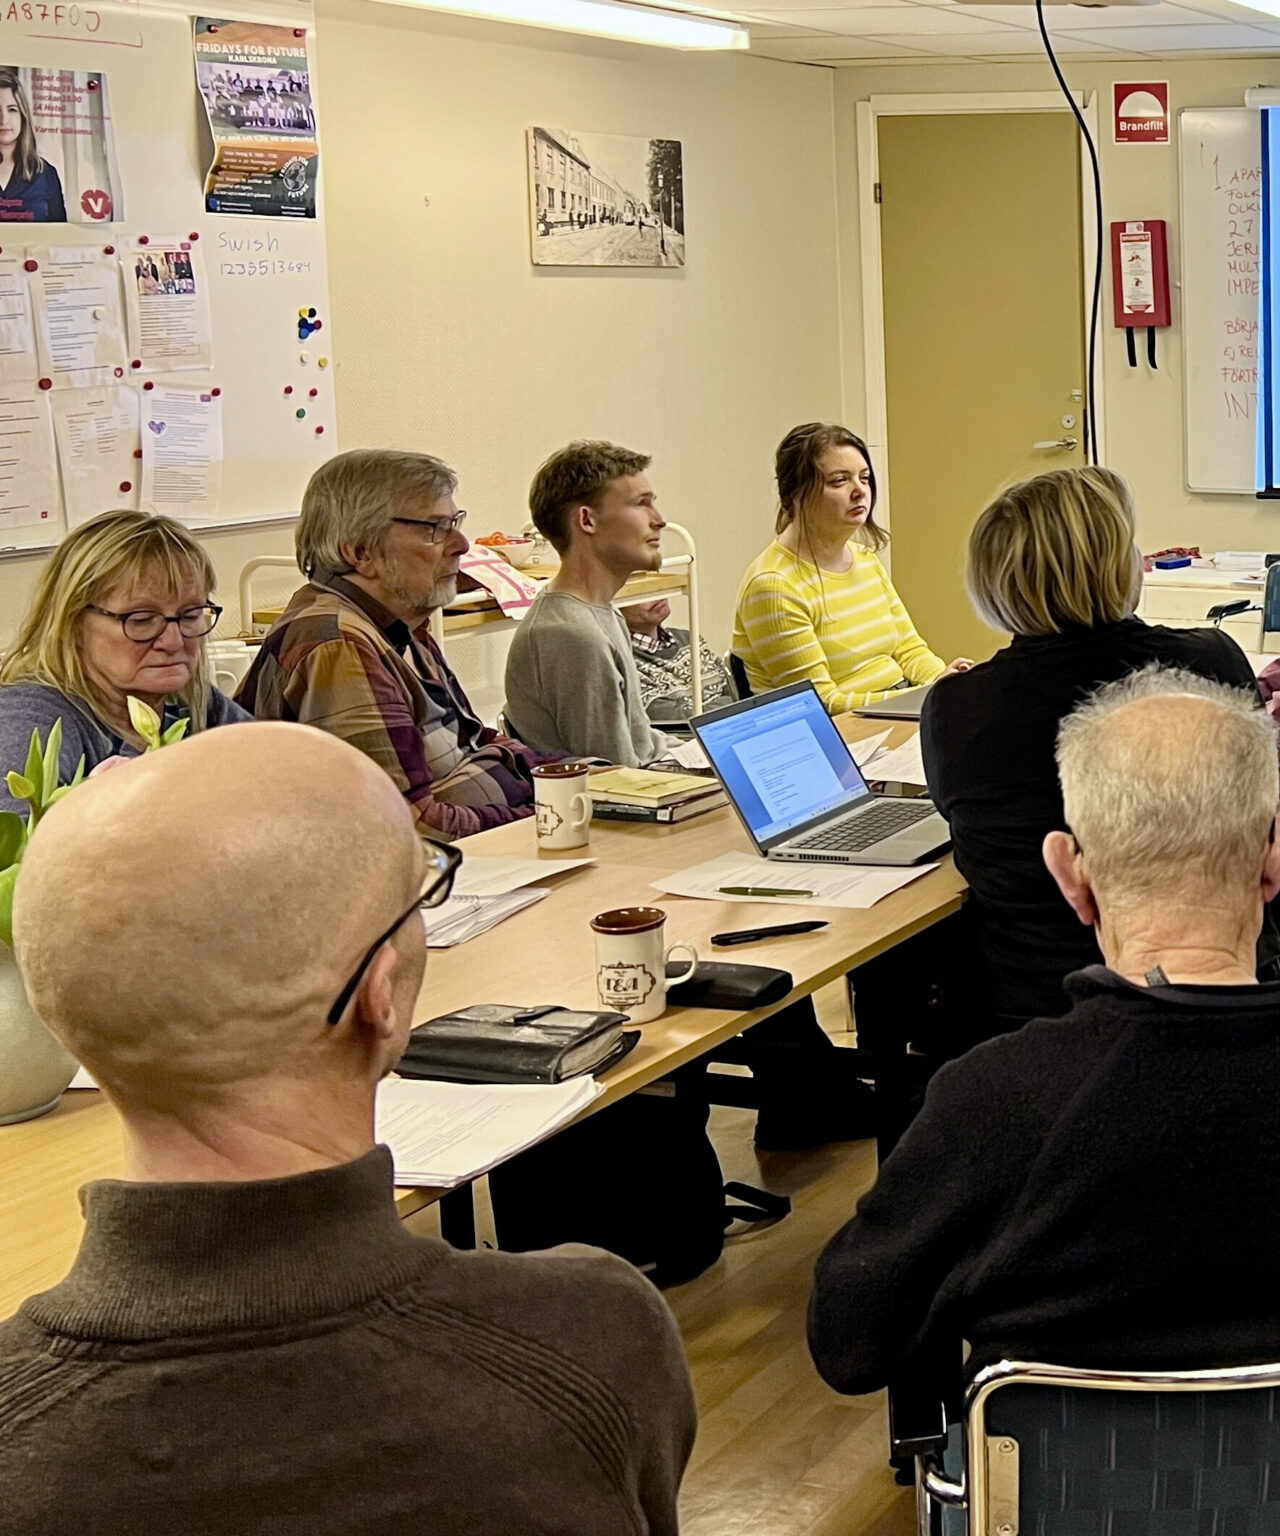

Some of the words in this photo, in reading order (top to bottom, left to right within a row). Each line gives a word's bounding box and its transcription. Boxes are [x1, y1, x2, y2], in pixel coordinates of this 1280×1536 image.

[196, 42, 241, 55] FRIDAYS
[243, 44, 265, 56] FOR
[267, 46, 306, 58] FUTURE
[227, 55, 278, 65] KARLSKRONA
[1119, 120, 1164, 131] Brandfilt
[218, 231, 279, 252] Swish
